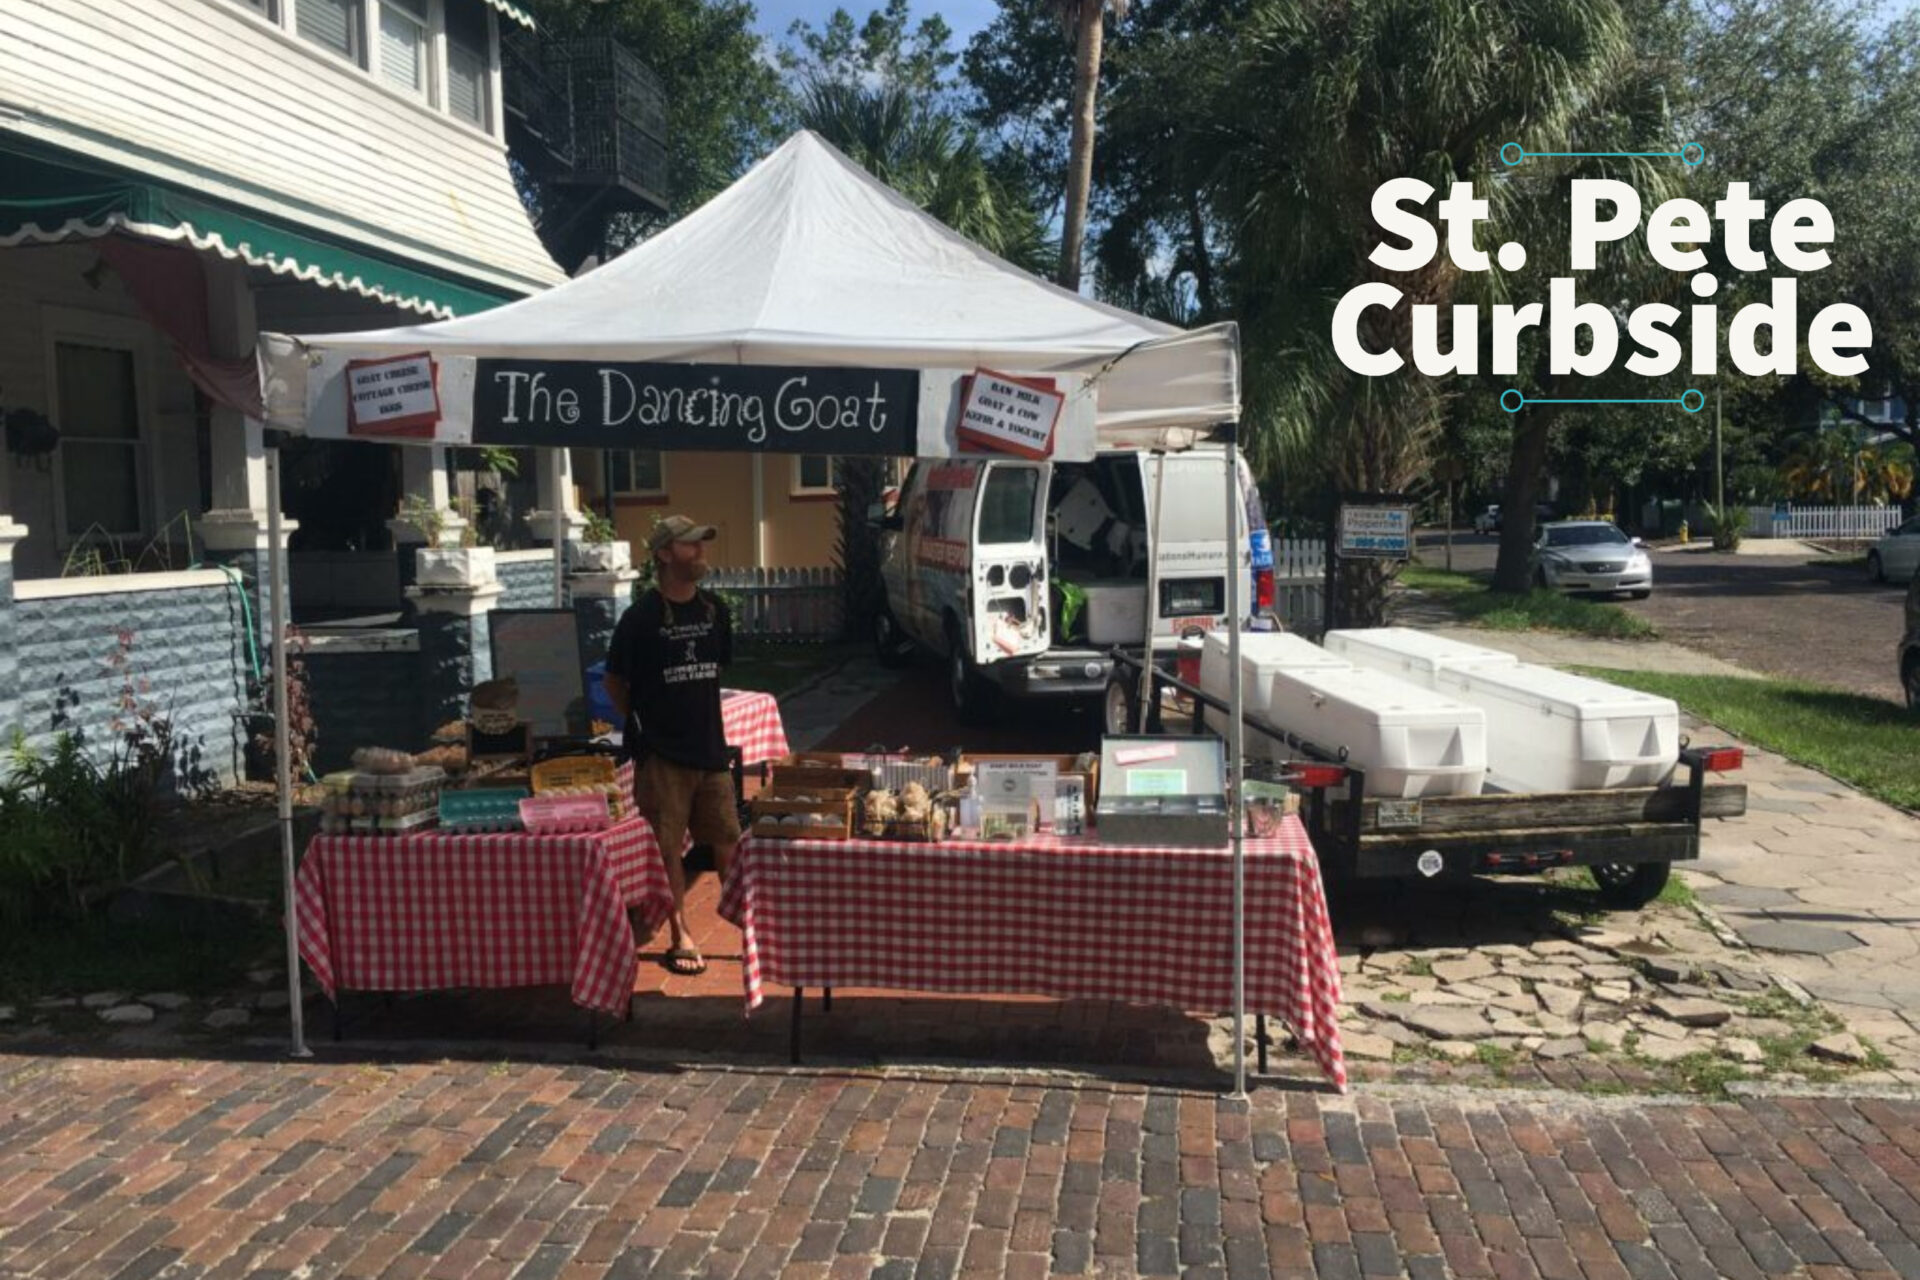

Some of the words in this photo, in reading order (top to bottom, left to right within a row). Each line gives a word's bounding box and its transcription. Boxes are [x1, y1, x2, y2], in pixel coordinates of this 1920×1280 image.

[494, 370, 580, 424] The
[598, 369, 767, 442] Dancing
[772, 374, 888, 433] Goat
[978, 395, 1005, 412] GOAT
[1017, 408, 1040, 422] COW
[1017, 390, 1040, 405] MILK
[1008, 422, 1047, 442] YOGURT
